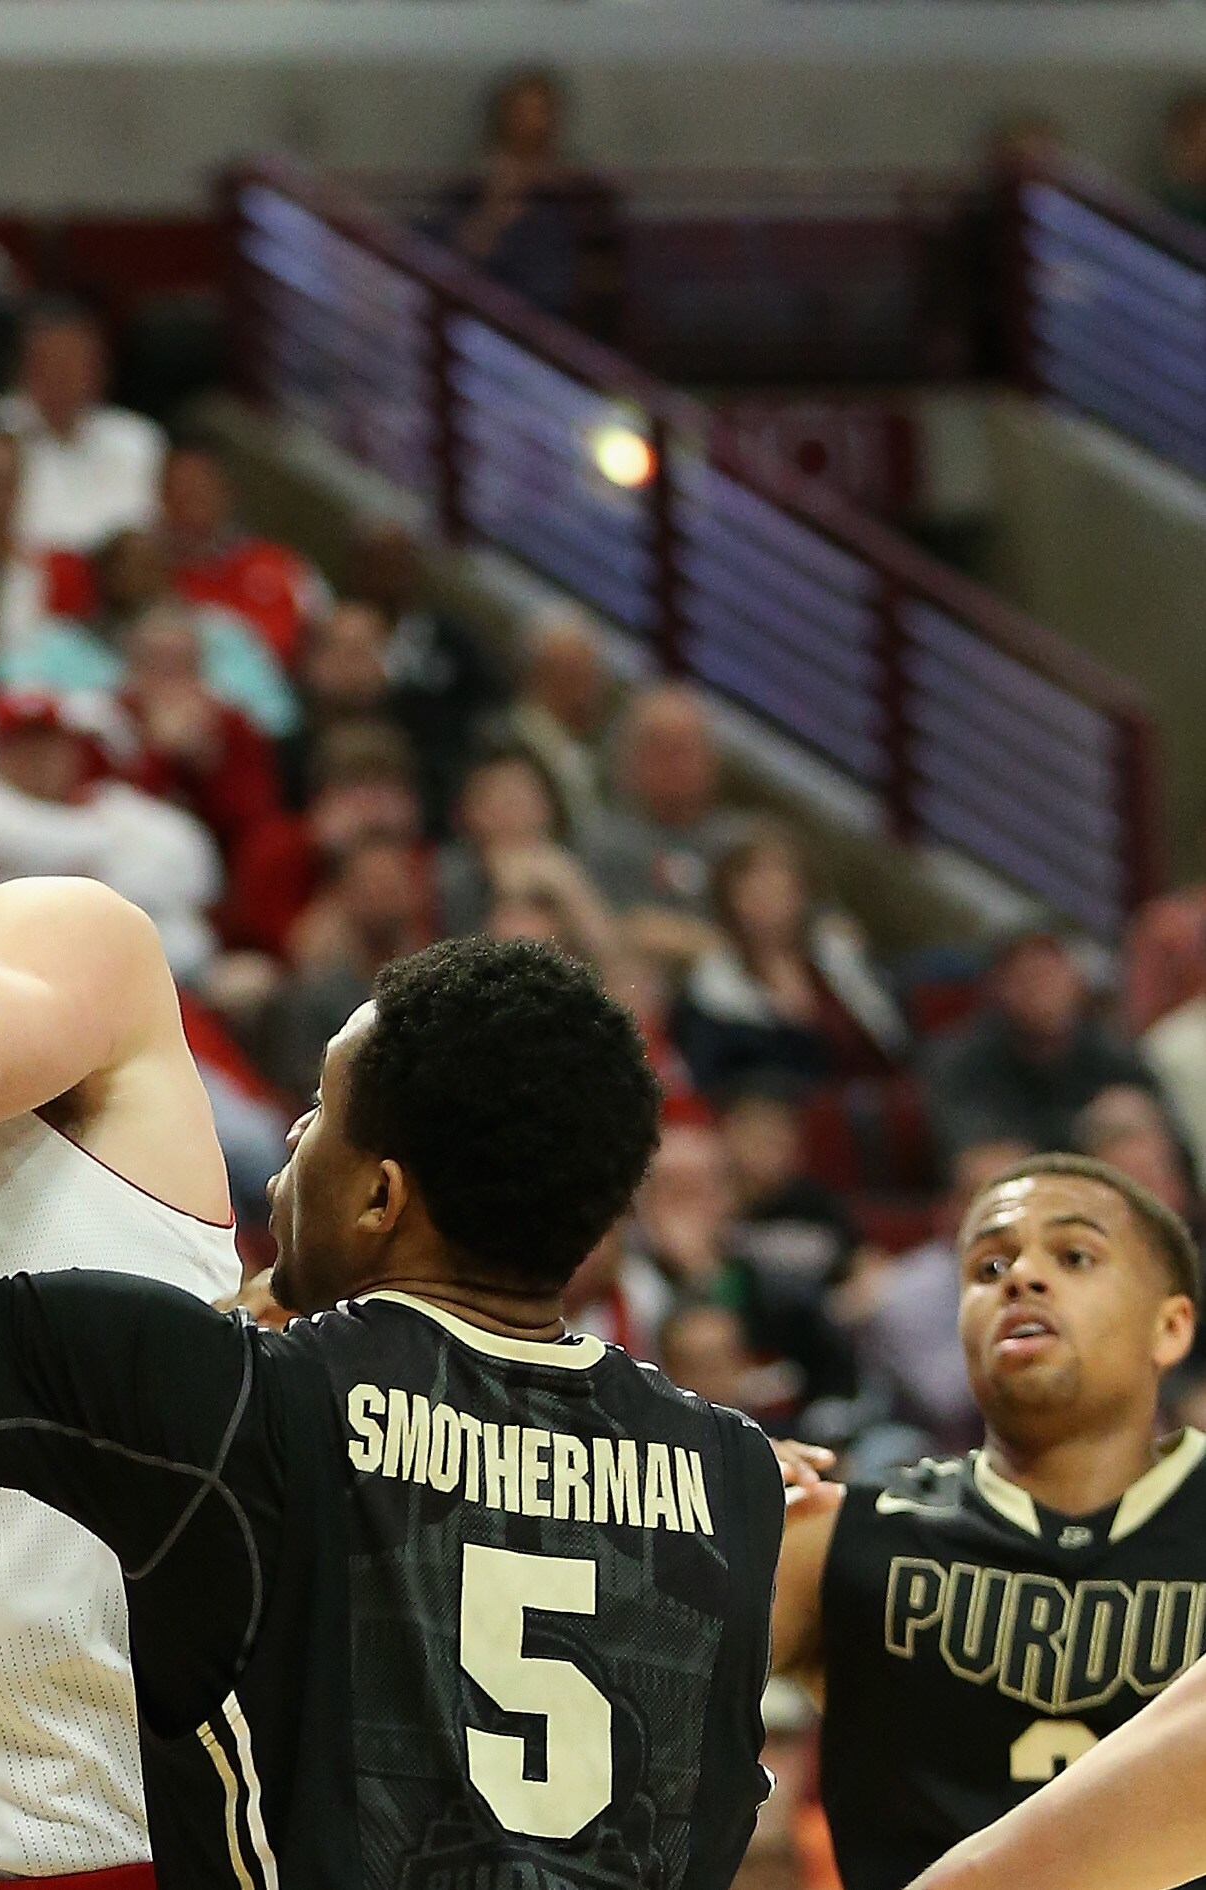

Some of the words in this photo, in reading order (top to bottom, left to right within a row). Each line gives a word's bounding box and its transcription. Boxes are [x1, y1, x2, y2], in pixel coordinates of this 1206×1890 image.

[347, 1383, 714, 1536] SMOTHERMAN
[460, 1542, 612, 1840] 5
[884, 1556, 1206, 1715] PURDU
